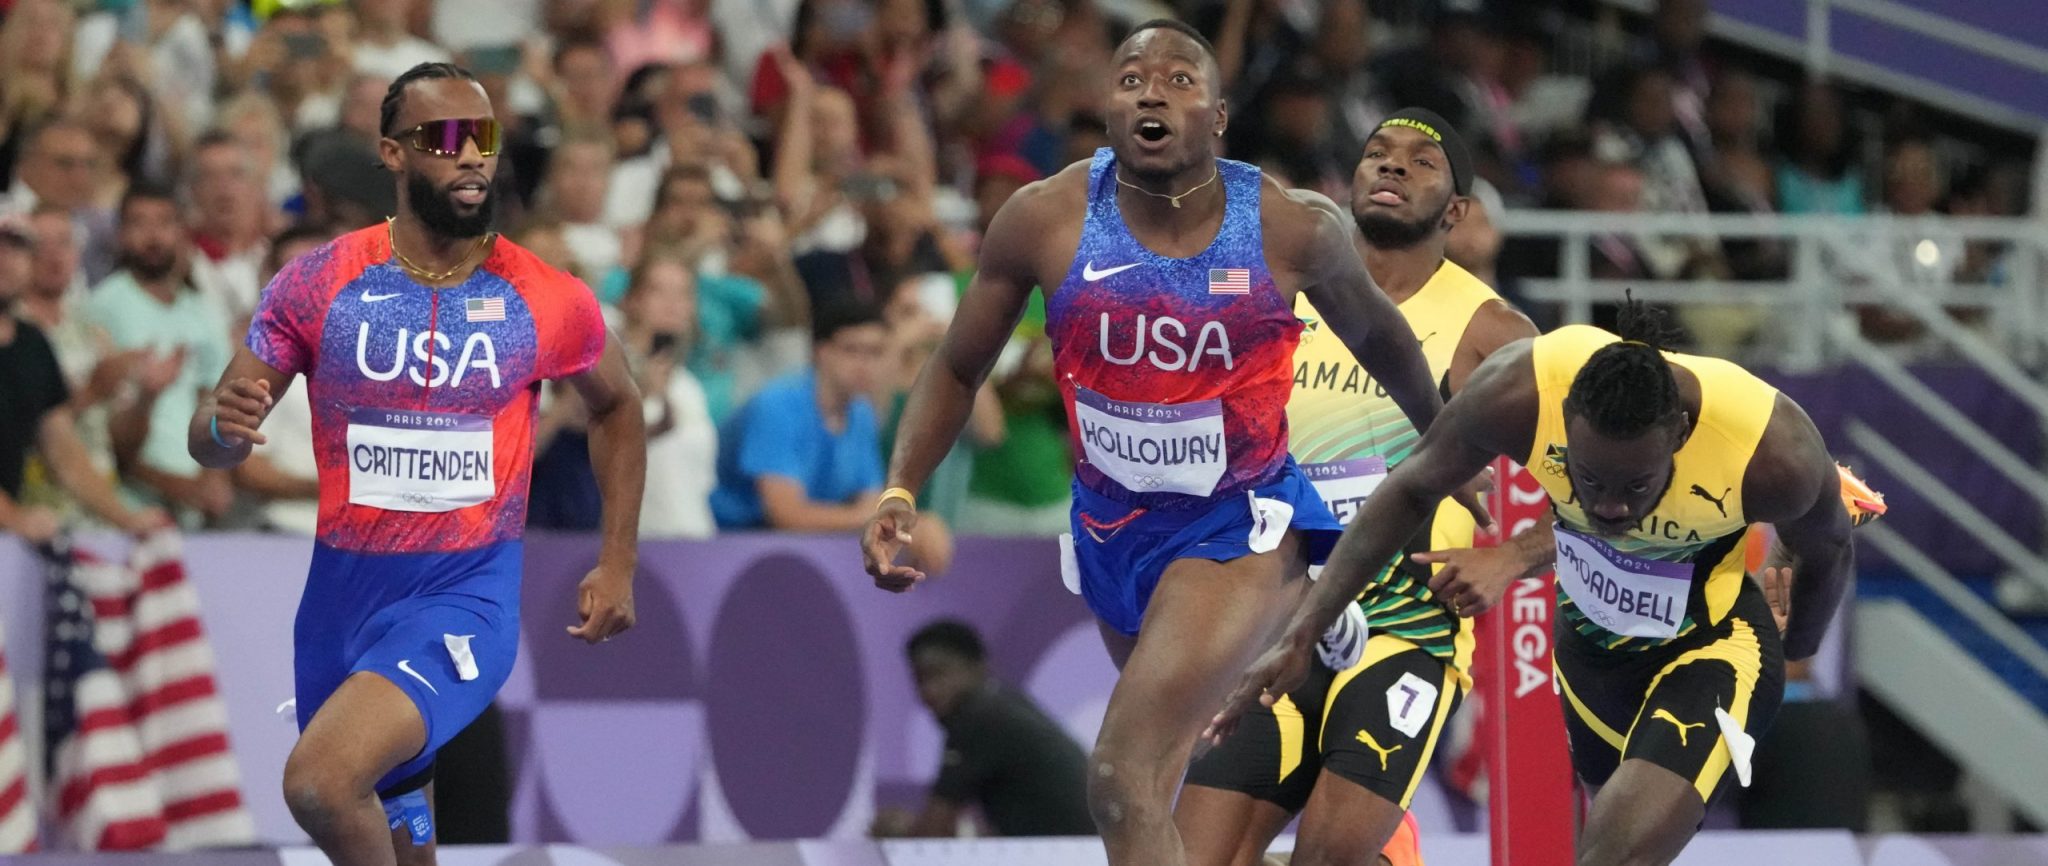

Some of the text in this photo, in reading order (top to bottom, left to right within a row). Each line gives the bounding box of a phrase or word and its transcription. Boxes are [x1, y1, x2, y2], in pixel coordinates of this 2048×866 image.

[356, 321, 501, 388] USA
[1100, 312, 1233, 373] USA
[1293, 360, 1389, 398] AMAI
[386, 413, 459, 427] PARIS 2024
[1107, 402, 1182, 418] PARIS 2024
[1081, 419, 1221, 466] HOLLOWAY
[353, 443, 489, 481] CRITTENDEN
[1315, 465, 1346, 476] 2024
[1615, 555, 1650, 571] 2024
[1400, 684, 1420, 719] 7
